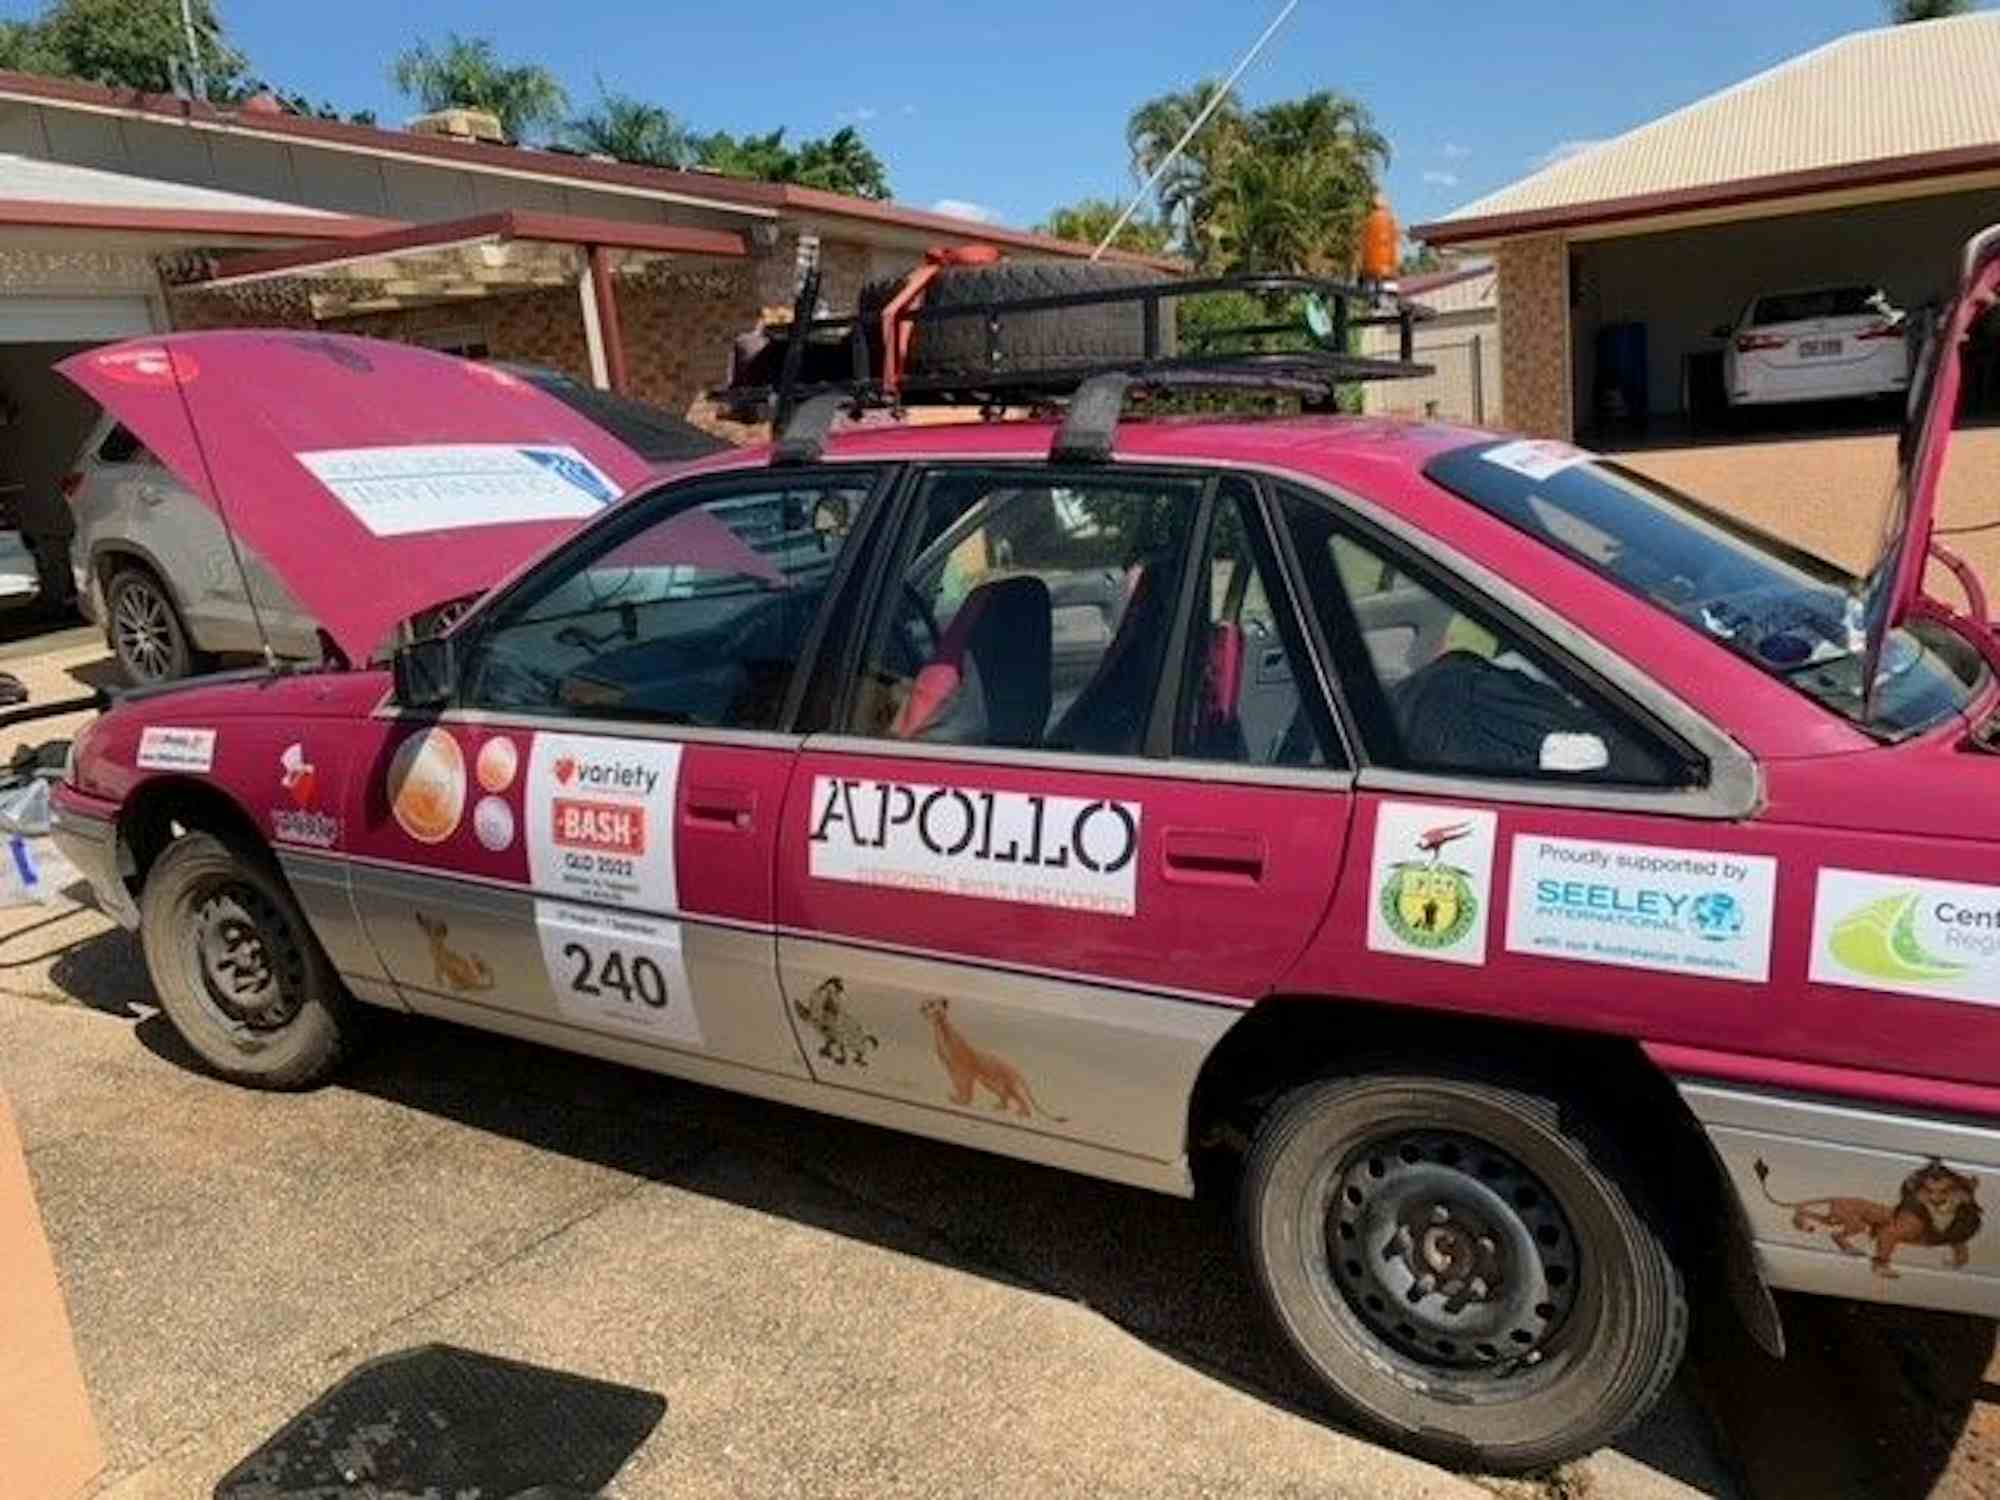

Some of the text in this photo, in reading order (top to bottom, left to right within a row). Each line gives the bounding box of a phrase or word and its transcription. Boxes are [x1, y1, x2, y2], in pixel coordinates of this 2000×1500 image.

[578, 762, 659, 794] variety
[565, 808, 631, 845] BASH
[810, 780, 1137, 873] APOLLO
[565, 852, 633, 876] QLD 2022
[1539, 843, 1748, 881] Proudly supported by
[1537, 880, 1689, 917] SEELEY
[1536, 906, 1686, 934] INTERNATIONAL
[563, 943, 668, 1008] 240
